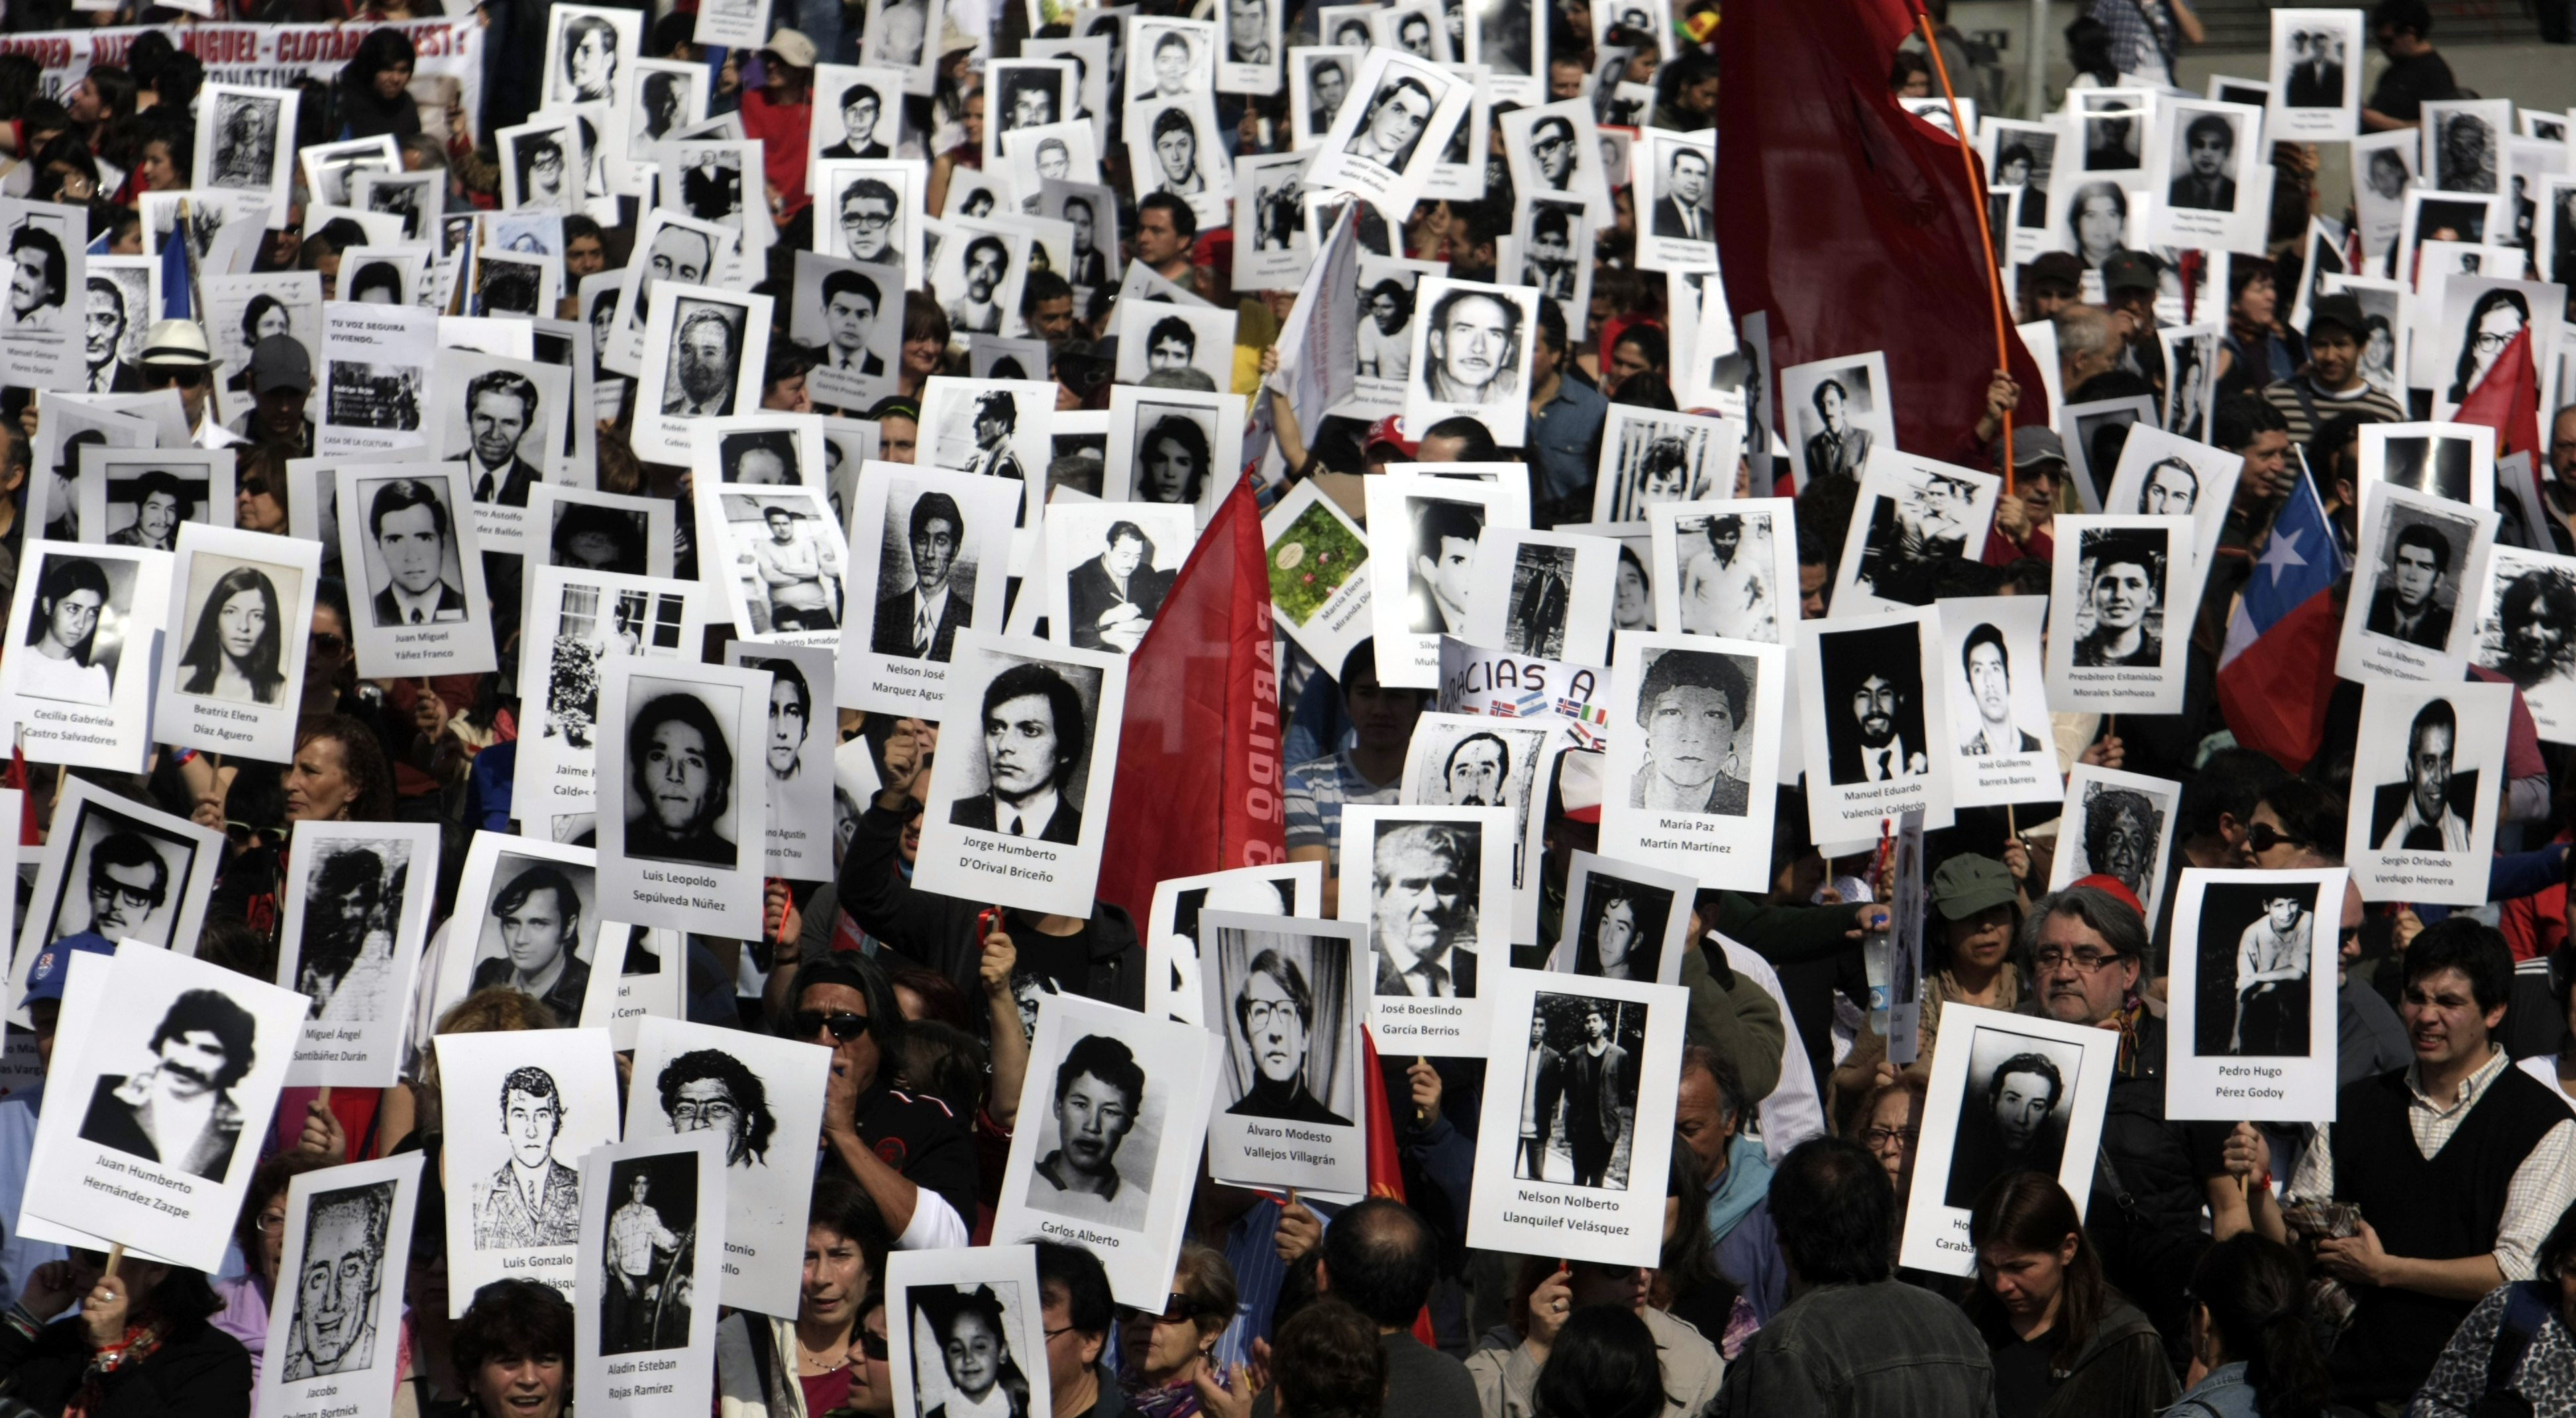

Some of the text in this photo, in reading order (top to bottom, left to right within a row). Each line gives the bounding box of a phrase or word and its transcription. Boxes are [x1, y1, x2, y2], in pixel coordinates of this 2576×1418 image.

[275, 28, 371, 63] CLOTAR
[331, 319, 405, 333] TU VOZ SEGUIRA
[490, 511, 523, 522] Astolfo
[1320, 576, 1364, 621] Marcia Elena
[1332, 603, 1362, 633] Miranda
[394, 631, 449, 643] Juan Miguel
[423, 649, 455, 659] Franco
[2377, 646, 2426, 667] Luis Alberto
[886, 663, 945, 681] Nelson José
[2361, 658, 2393, 677] Verdejo
[2116, 672, 2164, 682] Estanislao
[872, 681, 945, 702] Marquez Agus
[1568, 669, 1596, 704] A
[2072, 687, 2156, 698] Morales Sanhueza
[33, 709, 115, 728] Cecilia Gabriela
[193, 704, 258, 723] Beatriz Elena
[24, 727, 117, 746] Castro Salvadores
[193, 723, 215, 737] Díaz
[556, 764, 588, 777] Jaime
[1978, 758, 2031, 769] José Guillermo
[1978, 775, 2036, 787] Barrera Barrera
[1844, 783, 1922, 801] Manuel Eduardo
[1841, 800, 1927, 820] Valencia Calderón
[1660, 818, 1715, 832] María Paz
[778, 828, 806, 840] Agustín
[782, 847, 802, 859] Chau
[963, 836, 1057, 861] Jorge Humberto
[1640, 837, 1732, 854] Martín Martínez
[2381, 855, 2453, 868] Sergio Orlando
[642, 869, 717, 889] Luis Leopoldo
[1009, 866, 1054, 883] Briceño
[2375, 873, 2455, 887] Verdugo Herrera
[632, 890, 726, 912] Sepúlveda Núñez
[617, 1007, 647, 1018] Cerna
[1380, 1003, 1463, 1016] José Boeslindo
[304, 1026, 362, 1042] Miguel Ángel
[1381, 1023, 1460, 1037] García Berrios
[293, 1050, 368, 1062] Santibáñez Durán
[2218, 1065, 2282, 1079] Pedro Hugo
[2216, 1085, 2285, 1100] Pérez Godoy
[1246, 1121, 1332, 1144] Álvaro Modesto
[1243, 1146, 1336, 1167] Vallejos Villagrán
[95, 1154, 193, 1195] Juan Humberto
[83, 1175, 191, 1219] Hernández Zazpe
[1517, 1189, 1621, 1212] Nelson Nolberto
[1503, 1211, 1631, 1237] Llanquilef Velásquez
[1040, 1221, 1120, 1248] Carlos Alberto
[724, 1241, 756, 1257] tonio
[1935, 1237, 1976, 1254] Caraba
[502, 1254, 574, 1269] Luis Gonzalo
[638, 1359, 677, 1373] Esteban
[305, 1385, 339, 1399] Jacobo
[608, 1382, 674, 1401] Rojas Ramírez
[320, 1403, 359, 1418] Bortnick
